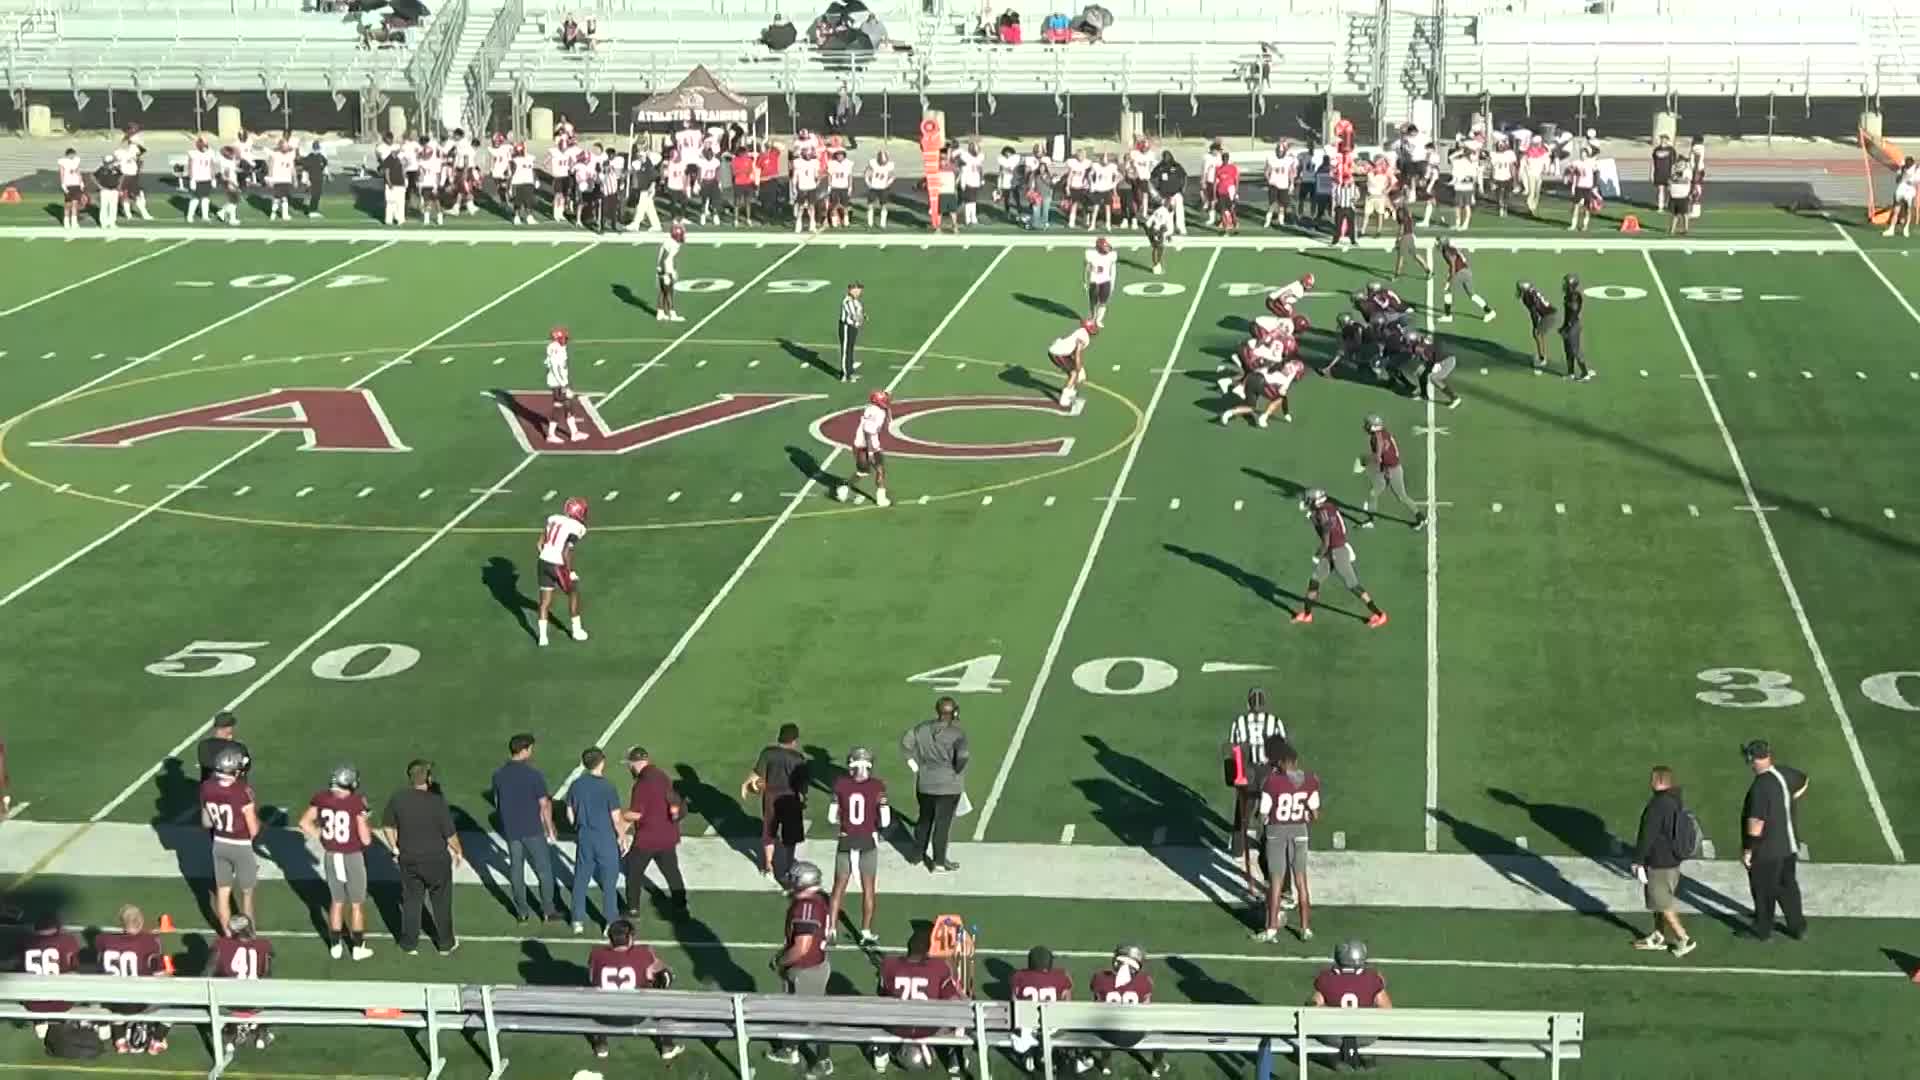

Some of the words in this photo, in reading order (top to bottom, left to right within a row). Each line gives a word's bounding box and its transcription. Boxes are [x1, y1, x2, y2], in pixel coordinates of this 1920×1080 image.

[637, 110, 692, 122] ATHLETIC
[693, 109, 748, 122] TRAINING
[144, 640, 421, 681] 50
[906, 654, 1179, 695] 40
[206, 802, 233, 832] 87
[849, 793, 865, 825] 0
[1276, 792, 1308, 821] 85
[321, 809, 350, 843] 38
[25, 948, 60, 976] 56
[103, 950, 138, 977] 50
[231, 947, 258, 980] 41
[895, 976, 928, 1000] 75
